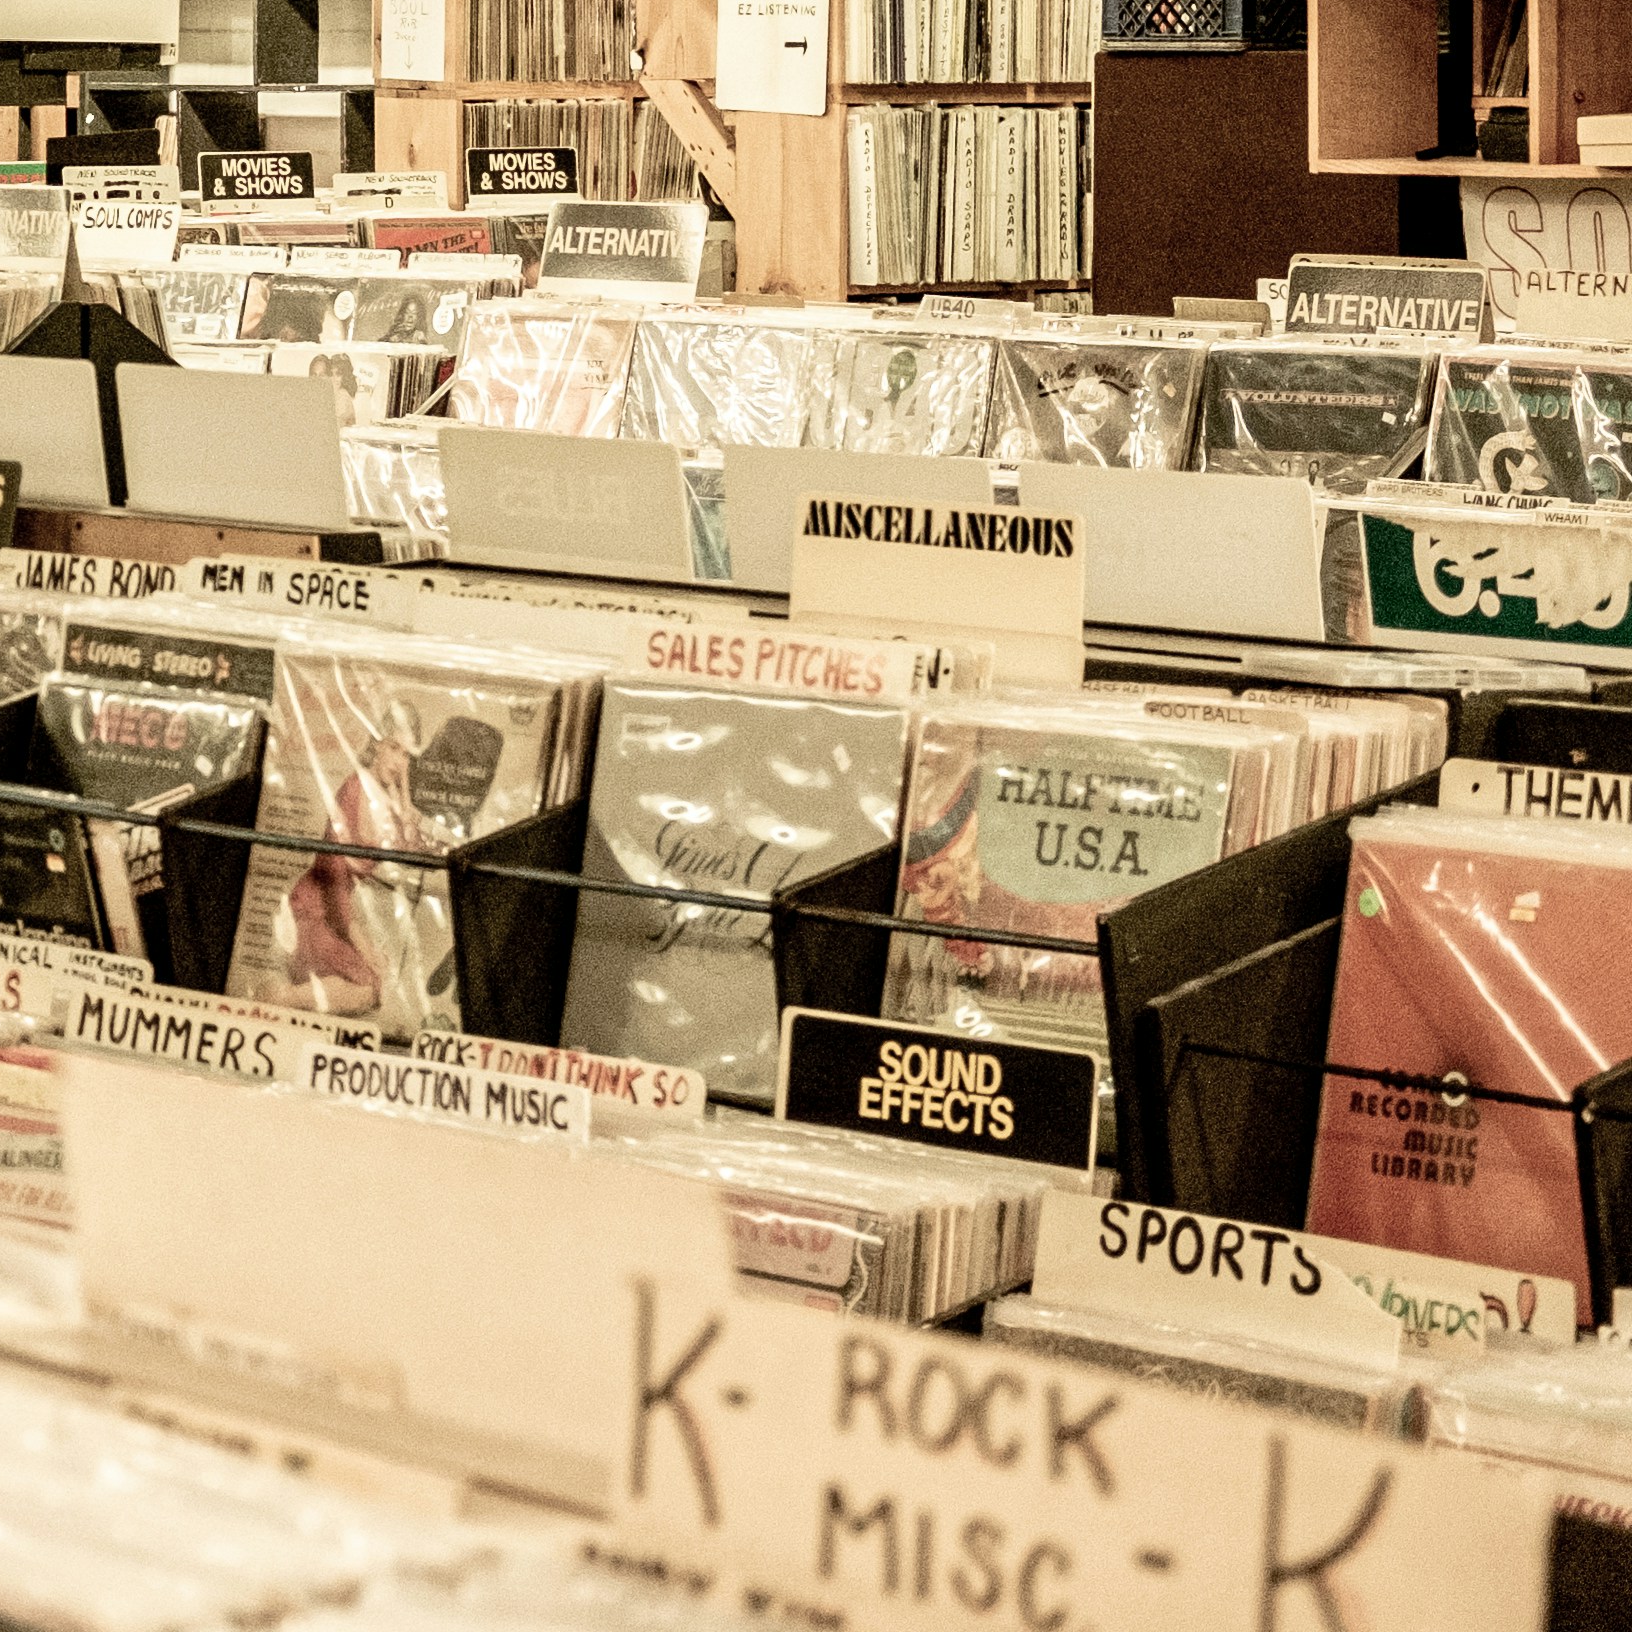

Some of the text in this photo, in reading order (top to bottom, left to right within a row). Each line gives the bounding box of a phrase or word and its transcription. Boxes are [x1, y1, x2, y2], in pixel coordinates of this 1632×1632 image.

[738, 4, 816, 16] EZ LISTENING
[222, 156, 291, 177] MOVIES
[481, 170, 566, 190] & SHOWS
[489, 152, 555, 171] MOVIES
[213, 175, 303, 196] & SHOWS
[83, 206, 123, 228] SOUL
[127, 211, 172, 229] COMPS
[931, 299, 975, 318] UB40
[1290, 292, 1478, 334] ALTERNATIVE
[803, 498, 1074, 558] MISCELLANEOUS
[202, 565, 369, 612] MEN IN SPACE
[88, 641, 212, 678] LIVING STEREO
[648, 631, 883, 695] SALES PITCHES
[1497, 765, 1632, 825] THEM
[77, 992, 278, 1080] MUMMERS
[879, 1040, 1002, 1099] SOUND
[311, 1054, 569, 1131] PRODUCTION MUSIC
[653, 1071, 690, 1108] SO
[859, 1079, 1013, 1141] EFFECTS
[1403, 1129, 1479, 1161] MUSIC
[1370, 1153, 1477, 1188] LIBRARY
[1100, 1202, 1323, 1298] SPORTS
[837, 1334, 1120, 1496] ROCK
